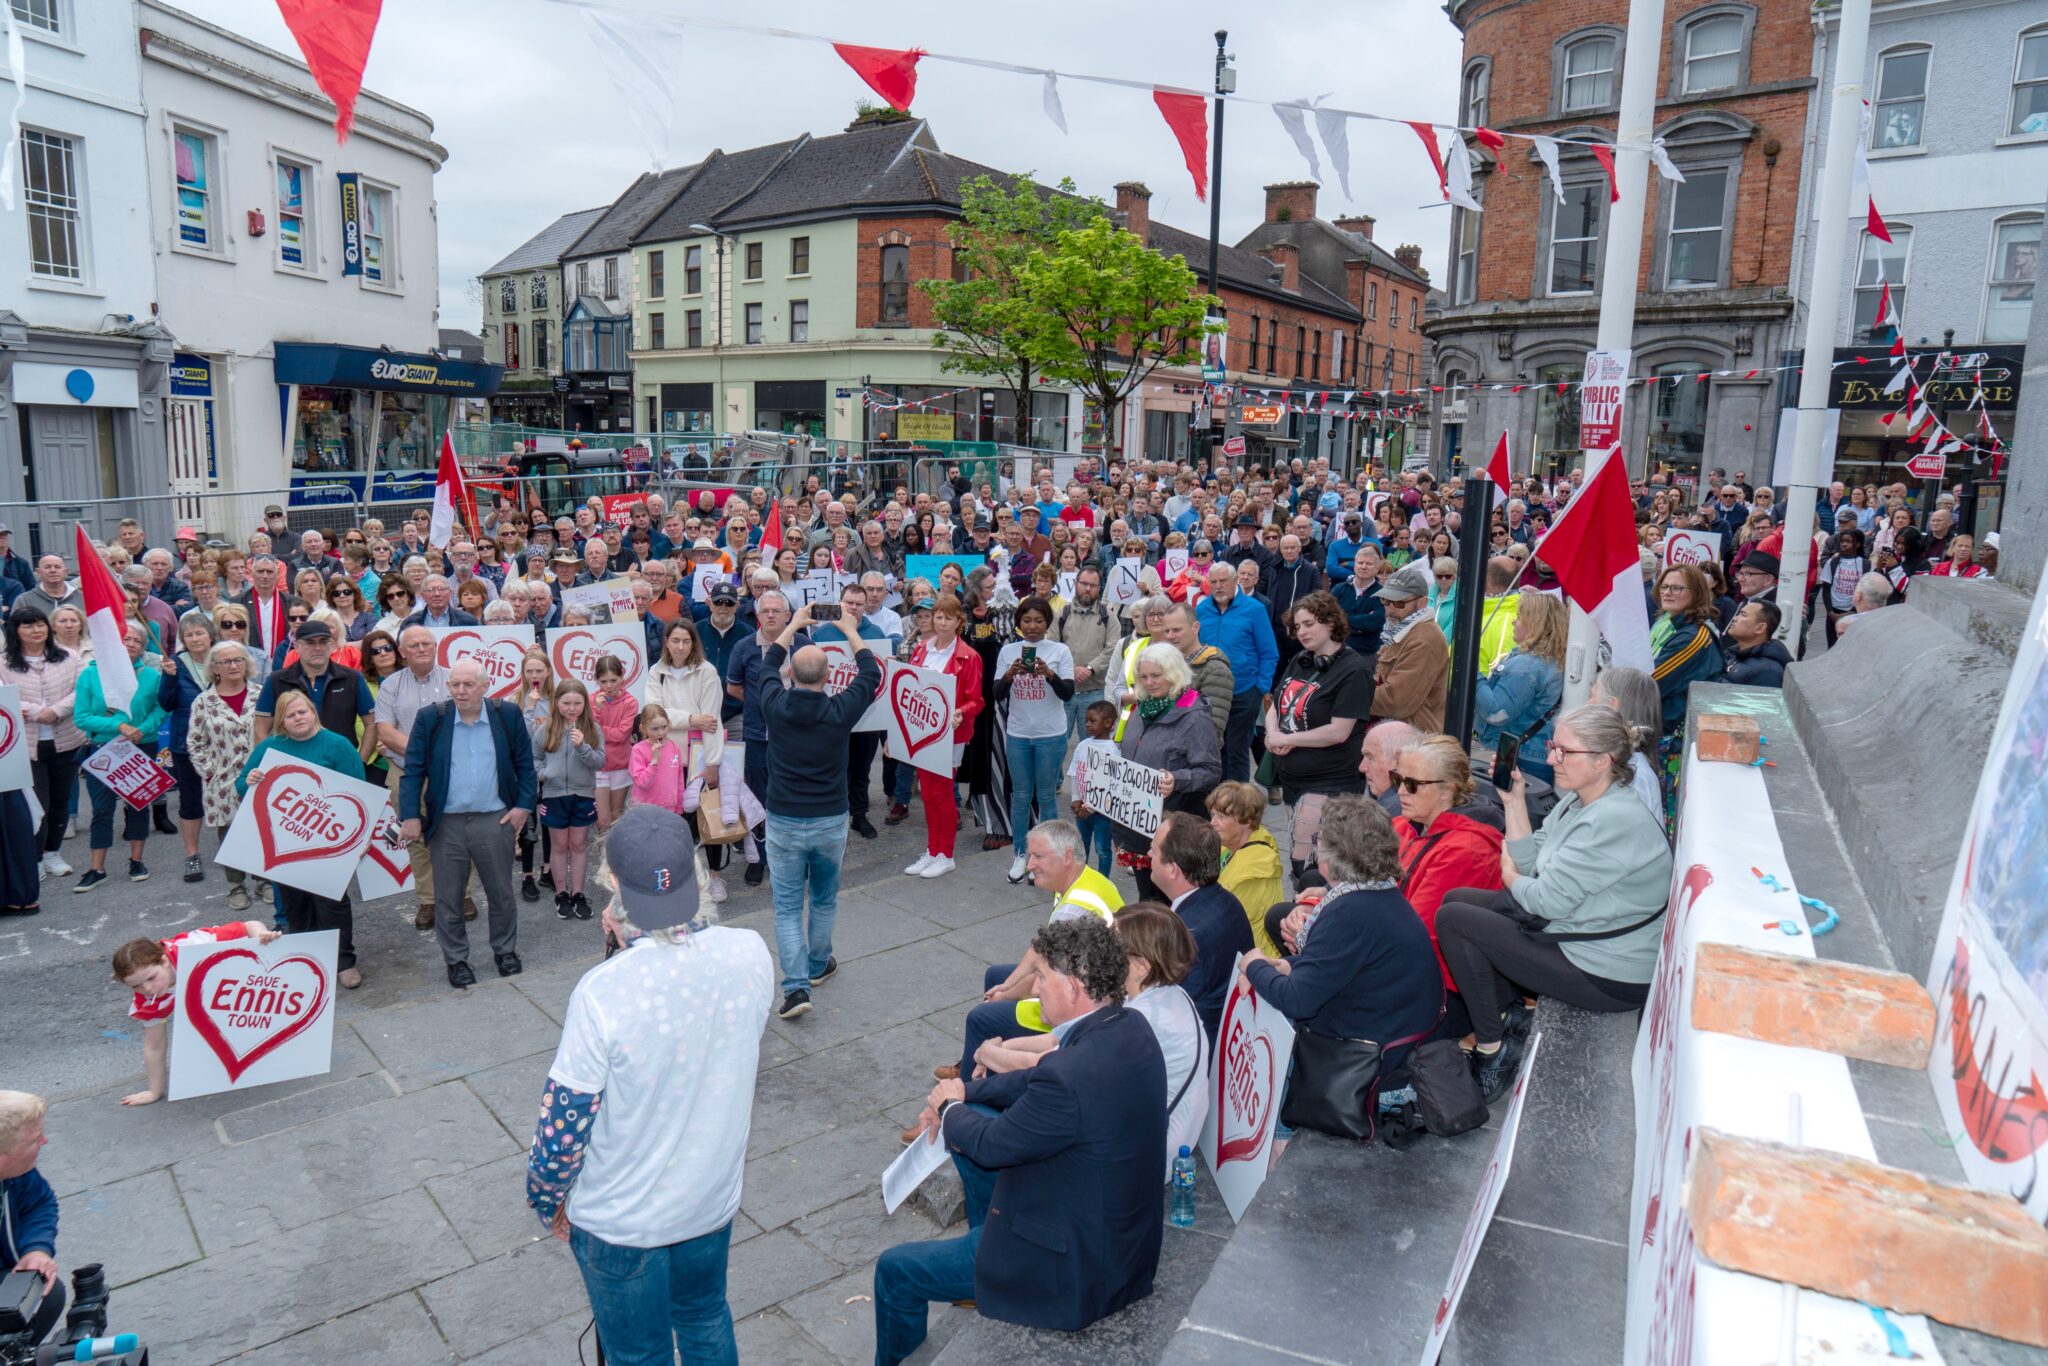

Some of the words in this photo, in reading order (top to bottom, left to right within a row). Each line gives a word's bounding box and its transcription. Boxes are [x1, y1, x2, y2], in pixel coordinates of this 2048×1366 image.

[1583, 386, 1620, 403] PUBLIC
[1838, 380, 1905, 404] EYE
[1922, 380, 2013, 404] CARE
[1915, 462, 1943, 470] MARKET
[1673, 547, 1700, 566] Enni
[1120, 565, 1139, 585] N
[612, 598, 632, 607] PUBLIC
[475, 648, 498, 659] SAVE
[588, 647, 610, 656] SAVE
[839, 662, 858, 672] SAVE
[1013, 679, 1045, 690] VOICE
[914, 690, 928, 704] SAVE
[1014, 690, 1046, 700] HEARD
[900, 687, 939, 728] Ennis
[907, 711, 925, 731] TOWN
[106, 753, 147, 785] PUBLIC
[1087, 747, 1100, 771] NO
[1122, 761, 1142, 789] 2040
[1108, 779, 1120, 791] for
[1122, 785, 1133, 799] the
[304, 792, 332, 814] SAVE
[1086, 780, 1105, 809] POST
[1104, 791, 1131, 825] OFFICE
[1130, 802, 1158, 834] FIELD
[271, 786, 345, 842] Ennis
[279, 816, 314, 842] TOWN
[246, 974, 281, 988] SAVE
[210, 978, 305, 1016] Ennis
[227, 1013, 272, 1029] TOWN
[1243, 1031, 1257, 1071] SAVE
[1227, 1018, 1260, 1128] Ennis
[1227, 1072, 1243, 1124] TOWN
